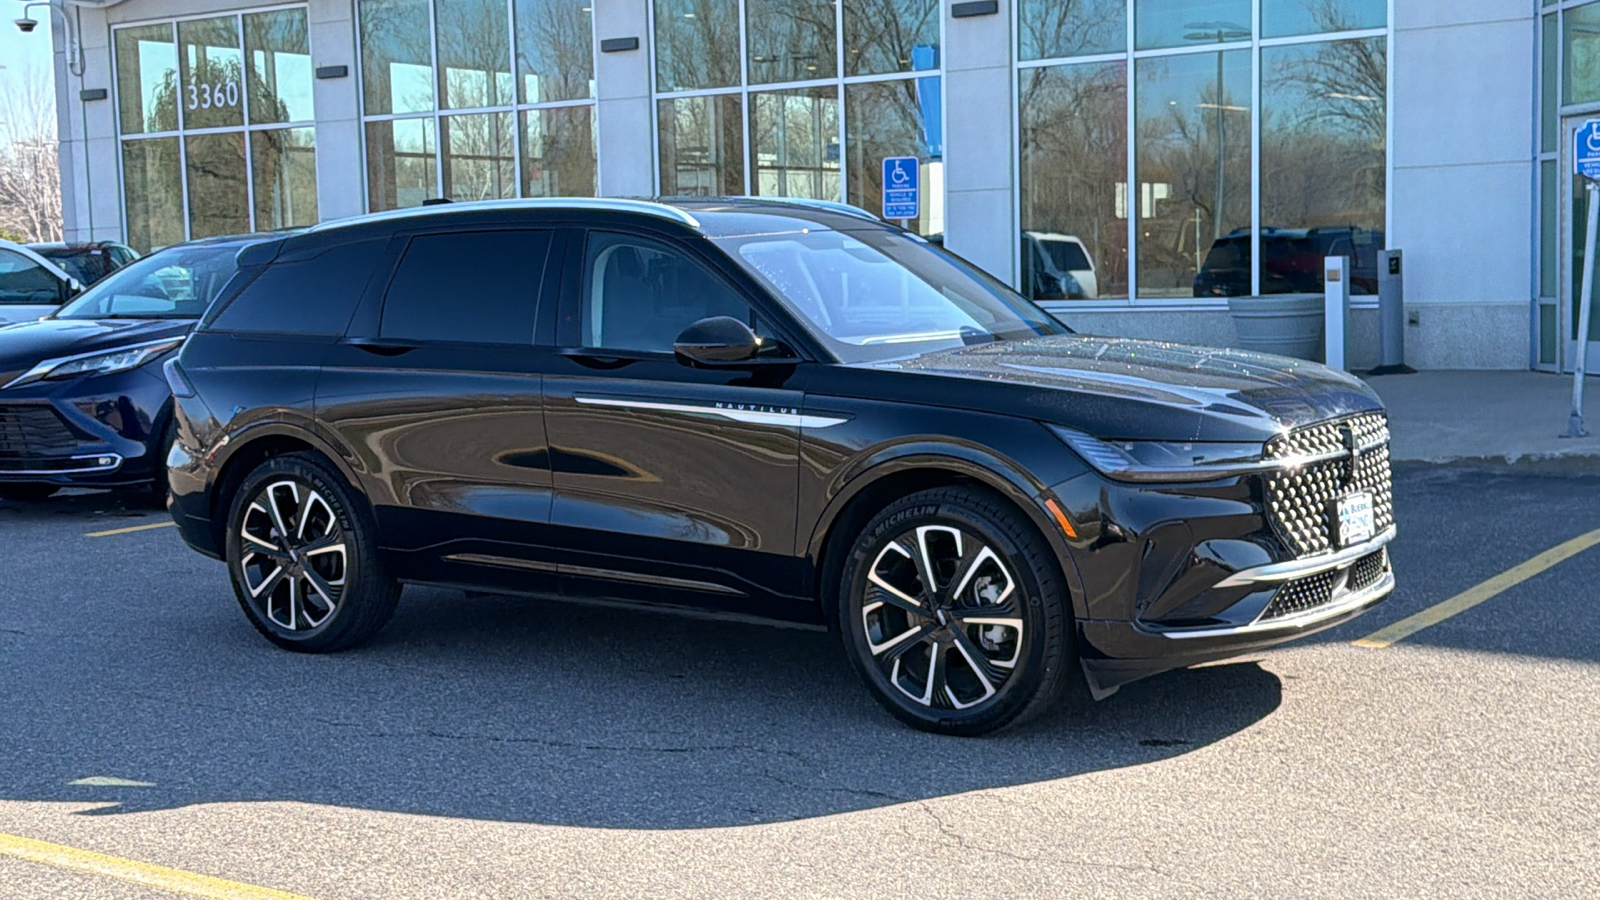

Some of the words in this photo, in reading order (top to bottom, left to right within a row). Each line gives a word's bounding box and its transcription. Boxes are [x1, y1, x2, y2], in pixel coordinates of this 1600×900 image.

[188, 82, 238, 109] 3360
[715, 402, 798, 414] NAUTILUS
[313, 478, 350, 529] MICHELIN
[875, 505, 937, 537] MICHELIN
